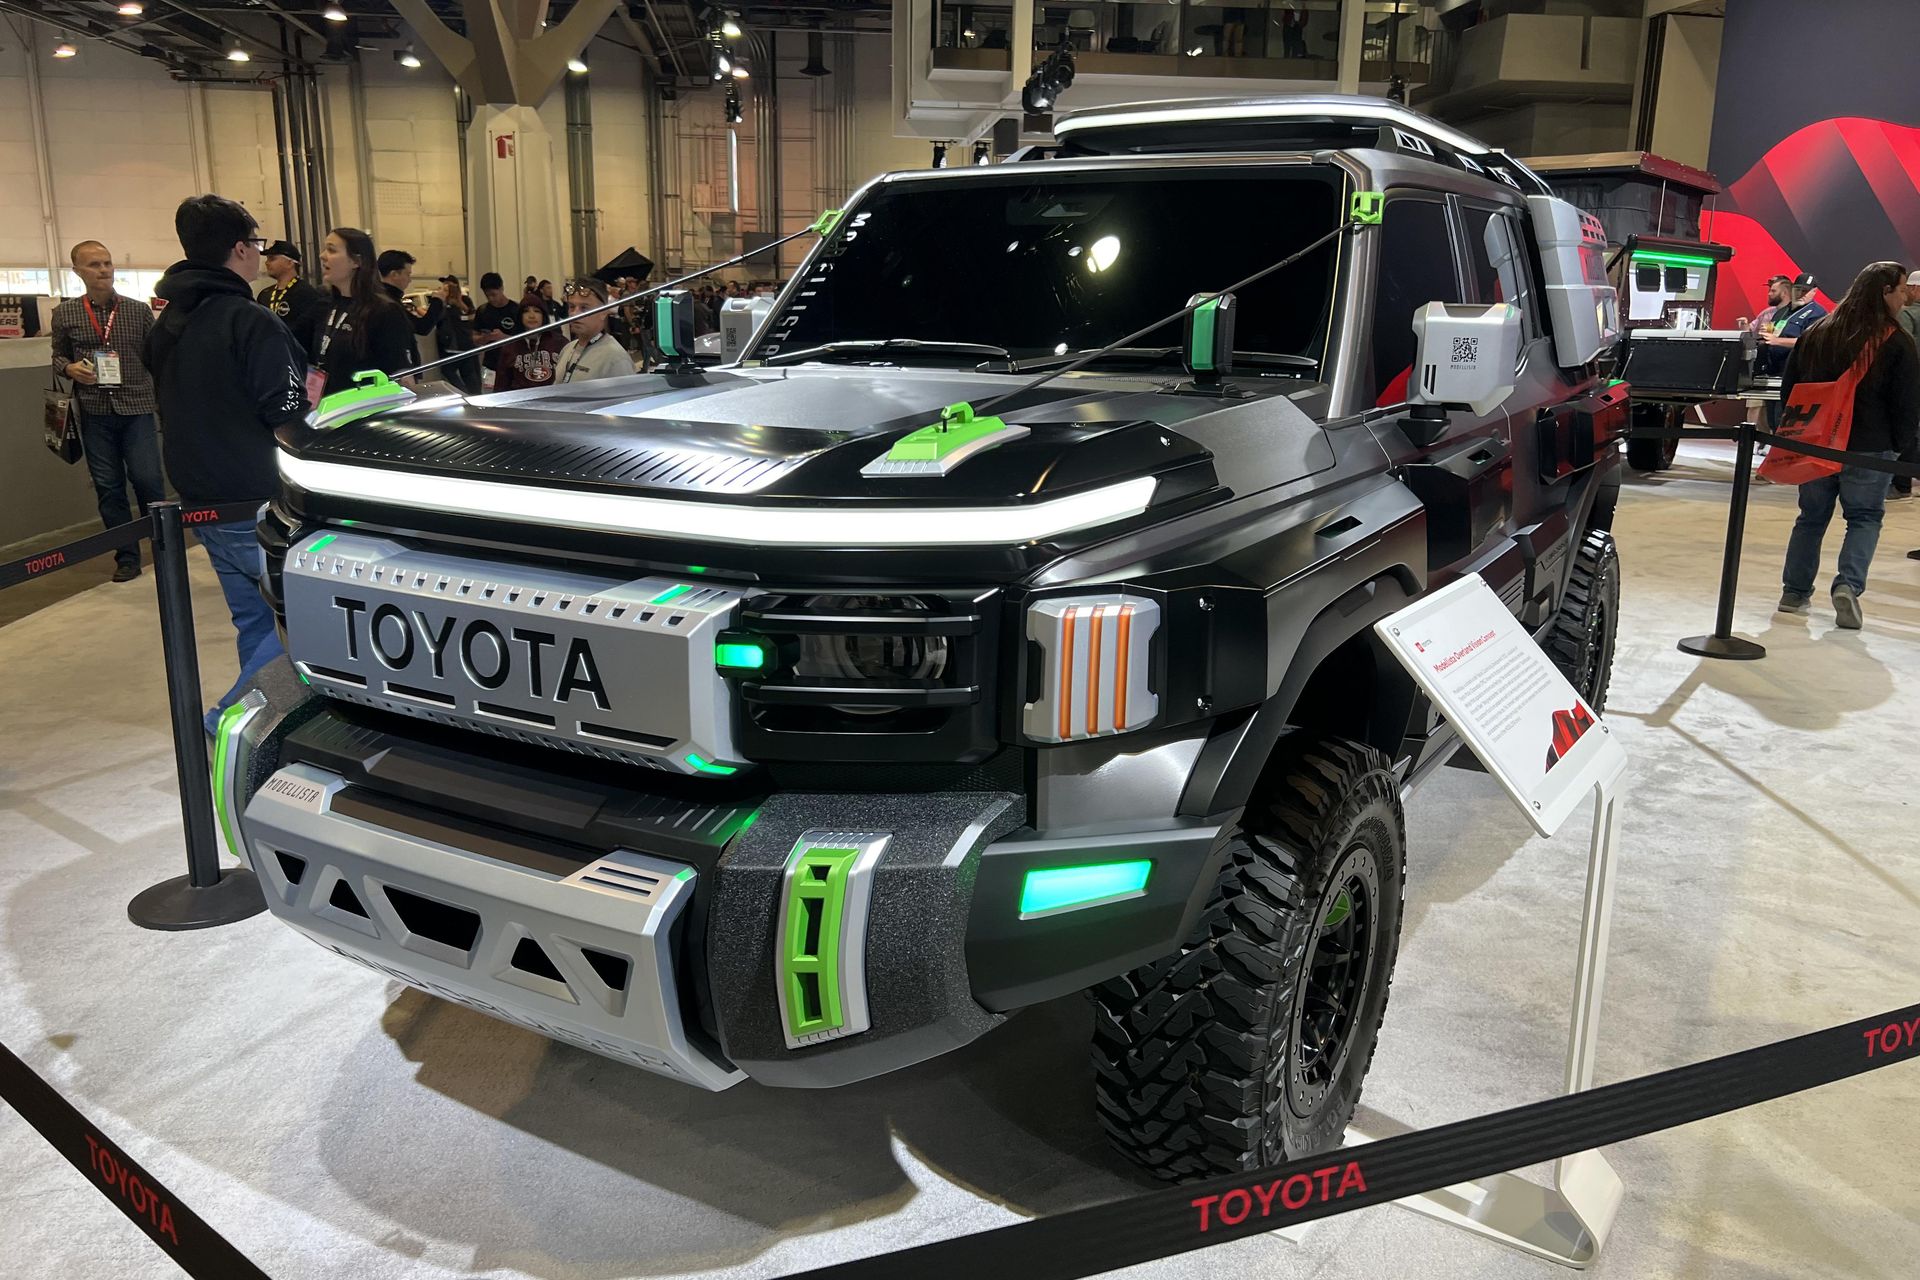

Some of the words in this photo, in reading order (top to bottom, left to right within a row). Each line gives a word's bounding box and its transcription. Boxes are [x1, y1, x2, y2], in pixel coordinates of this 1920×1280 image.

[182, 510, 219, 523] YOTA
[25, 552, 65, 575] TOYOTA
[332, 596, 612, 711] TOYOTA
[265, 777, 320, 803] MODELLISTA
[84, 1133, 178, 1245] TOYOTA
[1190, 1161, 1368, 1232] TOYOTA
